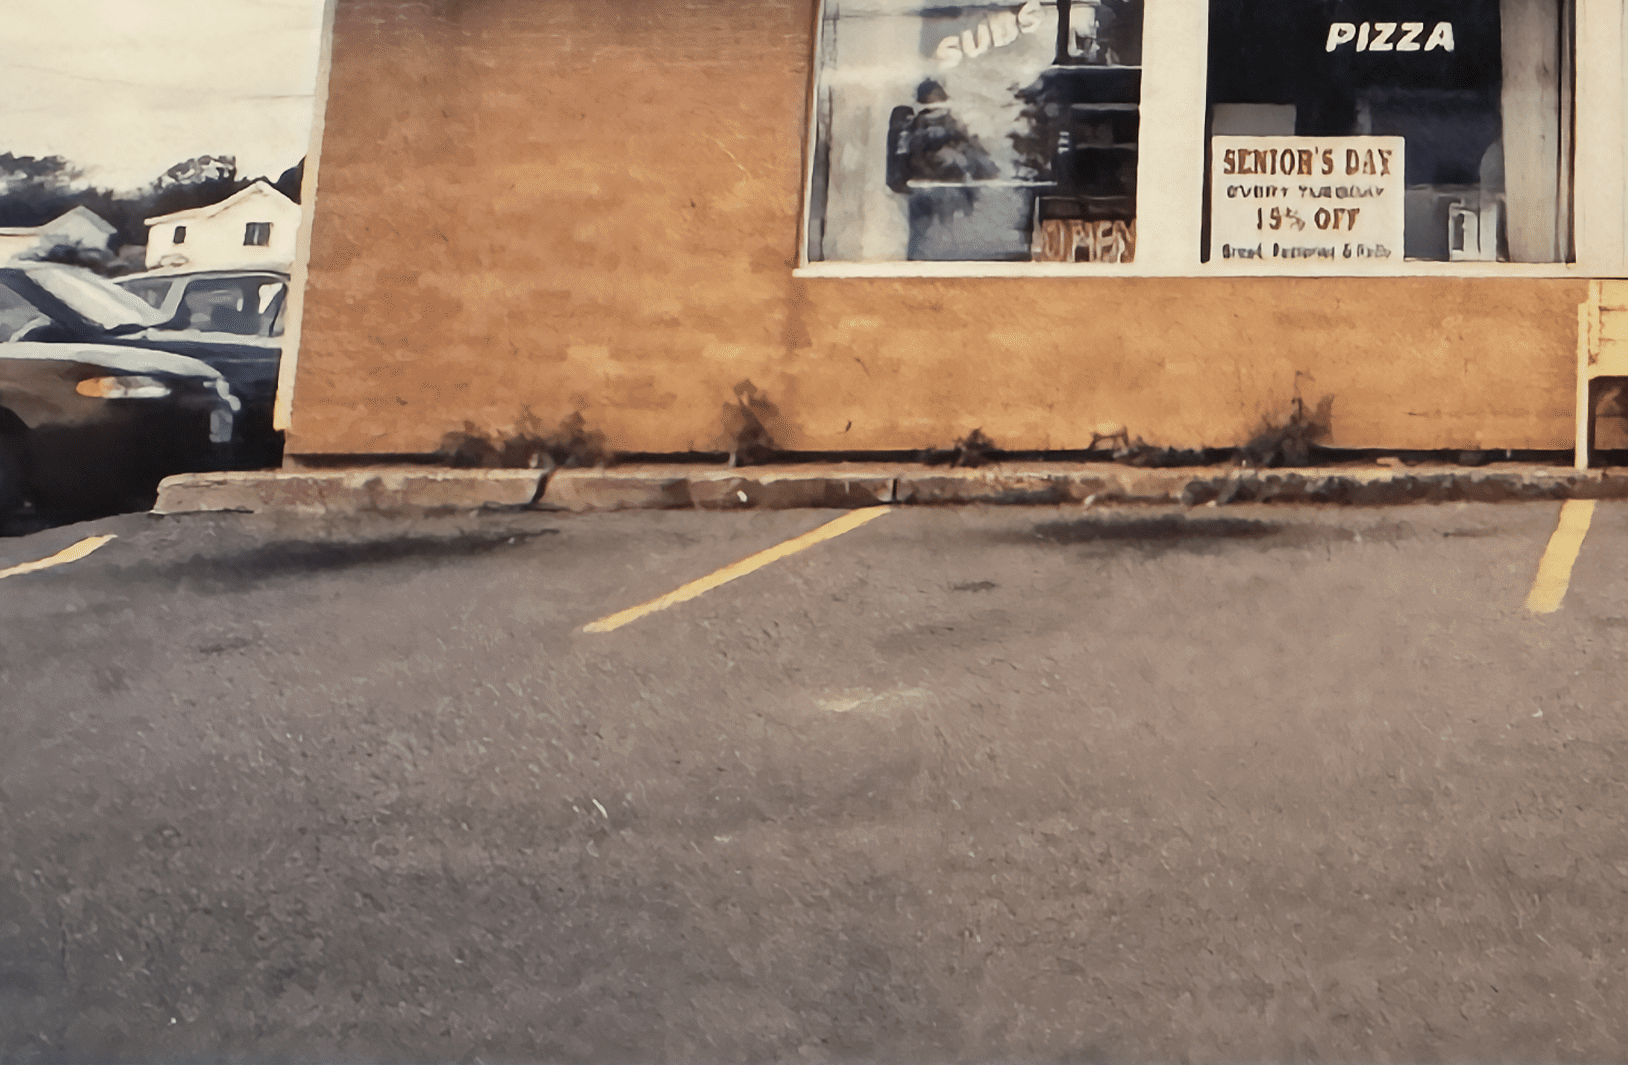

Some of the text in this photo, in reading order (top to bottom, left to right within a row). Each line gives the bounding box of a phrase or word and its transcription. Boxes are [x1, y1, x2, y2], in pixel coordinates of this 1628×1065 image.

[1325, 21, 1455, 52] PIZZA
[1223, 146, 1392, 176] SENIOR'S DAY
[1314, 206, 1360, 231] OFF
